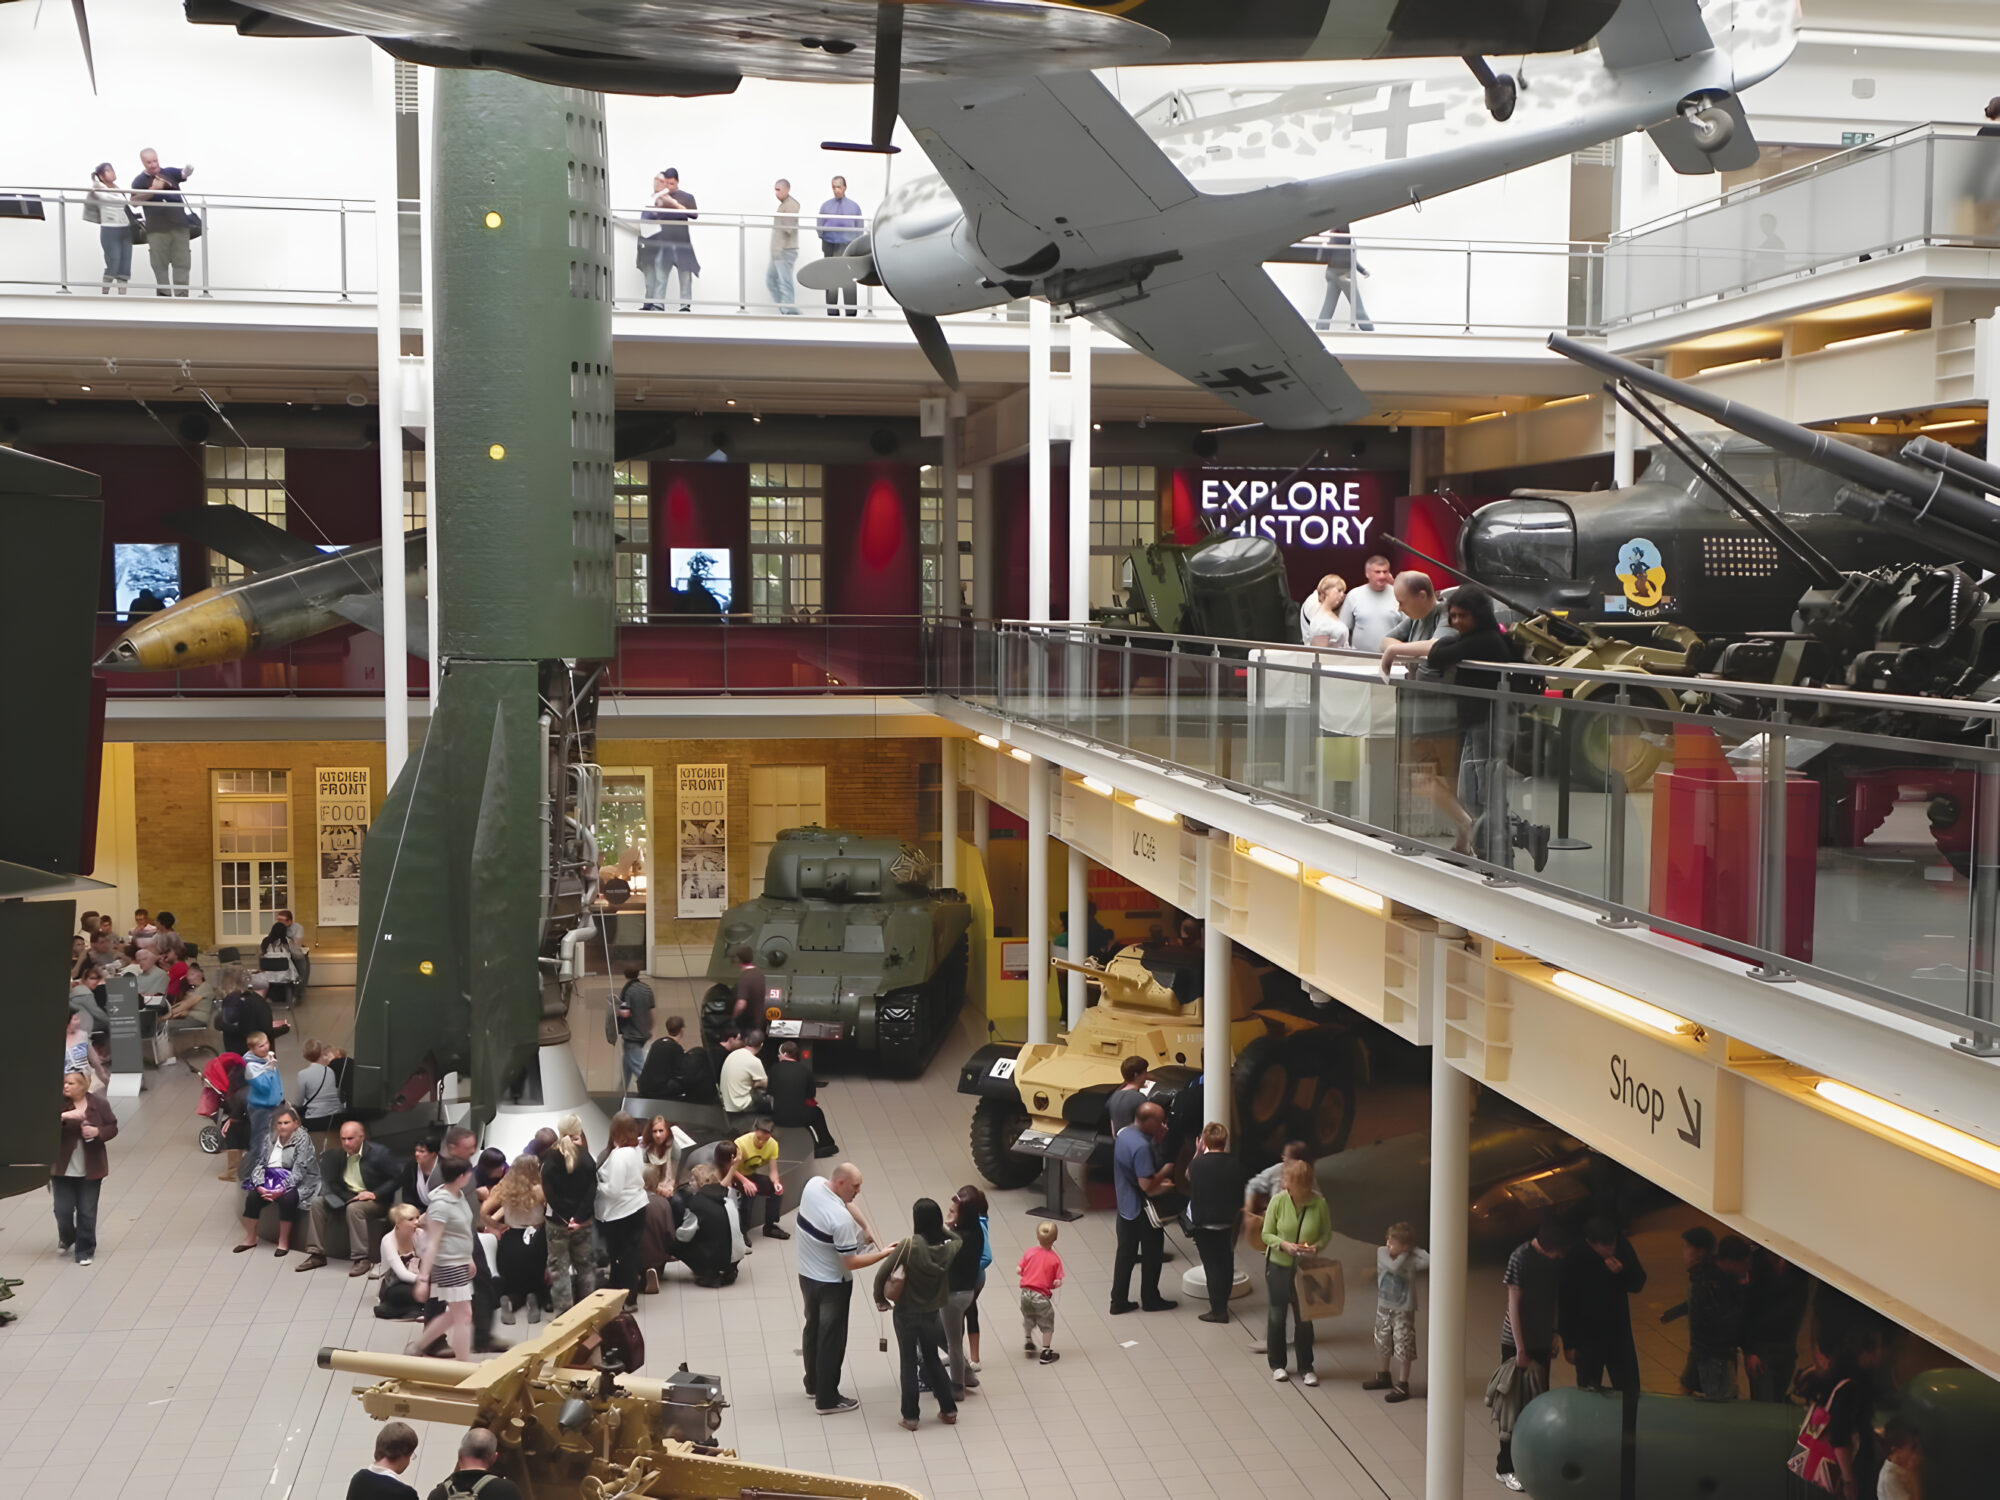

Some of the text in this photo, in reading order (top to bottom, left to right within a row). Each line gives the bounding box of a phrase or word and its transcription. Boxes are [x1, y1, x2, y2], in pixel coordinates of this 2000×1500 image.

[1202, 480, 1361, 511] EXPLORE
[319, 771, 367, 783] KITCHEN
[680, 779, 725, 791] FRONT
[320, 783, 367, 796] FRONT
[320, 805, 366, 822] FOOD
[681, 800, 724, 816] FOOD
[1610, 1054, 1665, 1135] Shop
